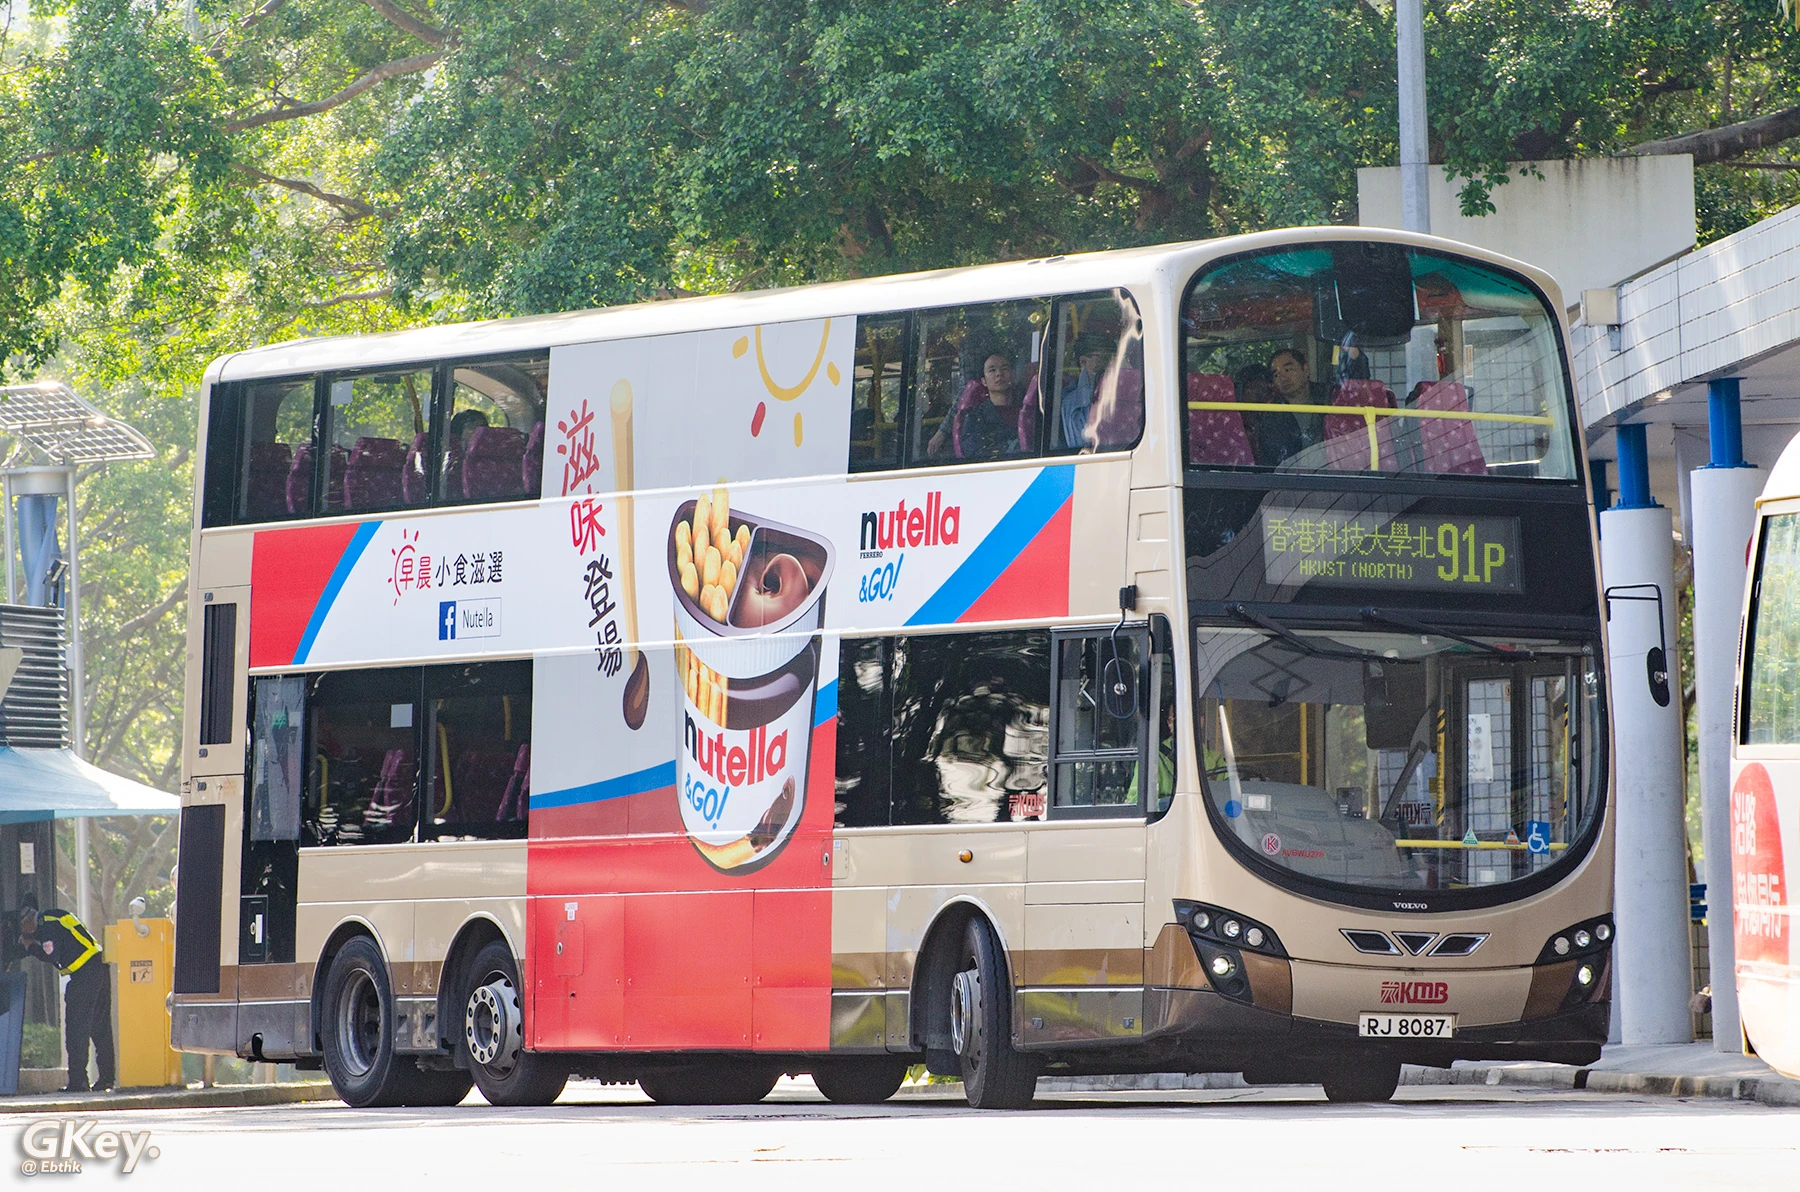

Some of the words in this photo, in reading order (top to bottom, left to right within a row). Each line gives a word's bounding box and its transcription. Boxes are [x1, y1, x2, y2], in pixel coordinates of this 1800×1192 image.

[557, 399, 623, 678] 滋味登場
[860, 491, 960, 550] nutella
[1267, 518, 1435, 558] 香港科技大學北
[860, 551, 883, 559] FERRERO
[1300, 559, 1346, 577] HKUST
[1351, 562, 1413, 580] (NORTH)
[1437, 523, 1505, 583] 91P
[859, 553, 904, 602] &GO!
[463, 607, 493, 628] Nutella
[685, 708, 788, 787] nutella
[685, 772, 730, 830] &GO!
[1393, 902, 1428, 910] VOLVO
[1400, 981, 1449, 1004] KMB
[1368, 1018, 1392, 1036] RJ
[1399, 1019, 1446, 1036] 8087
